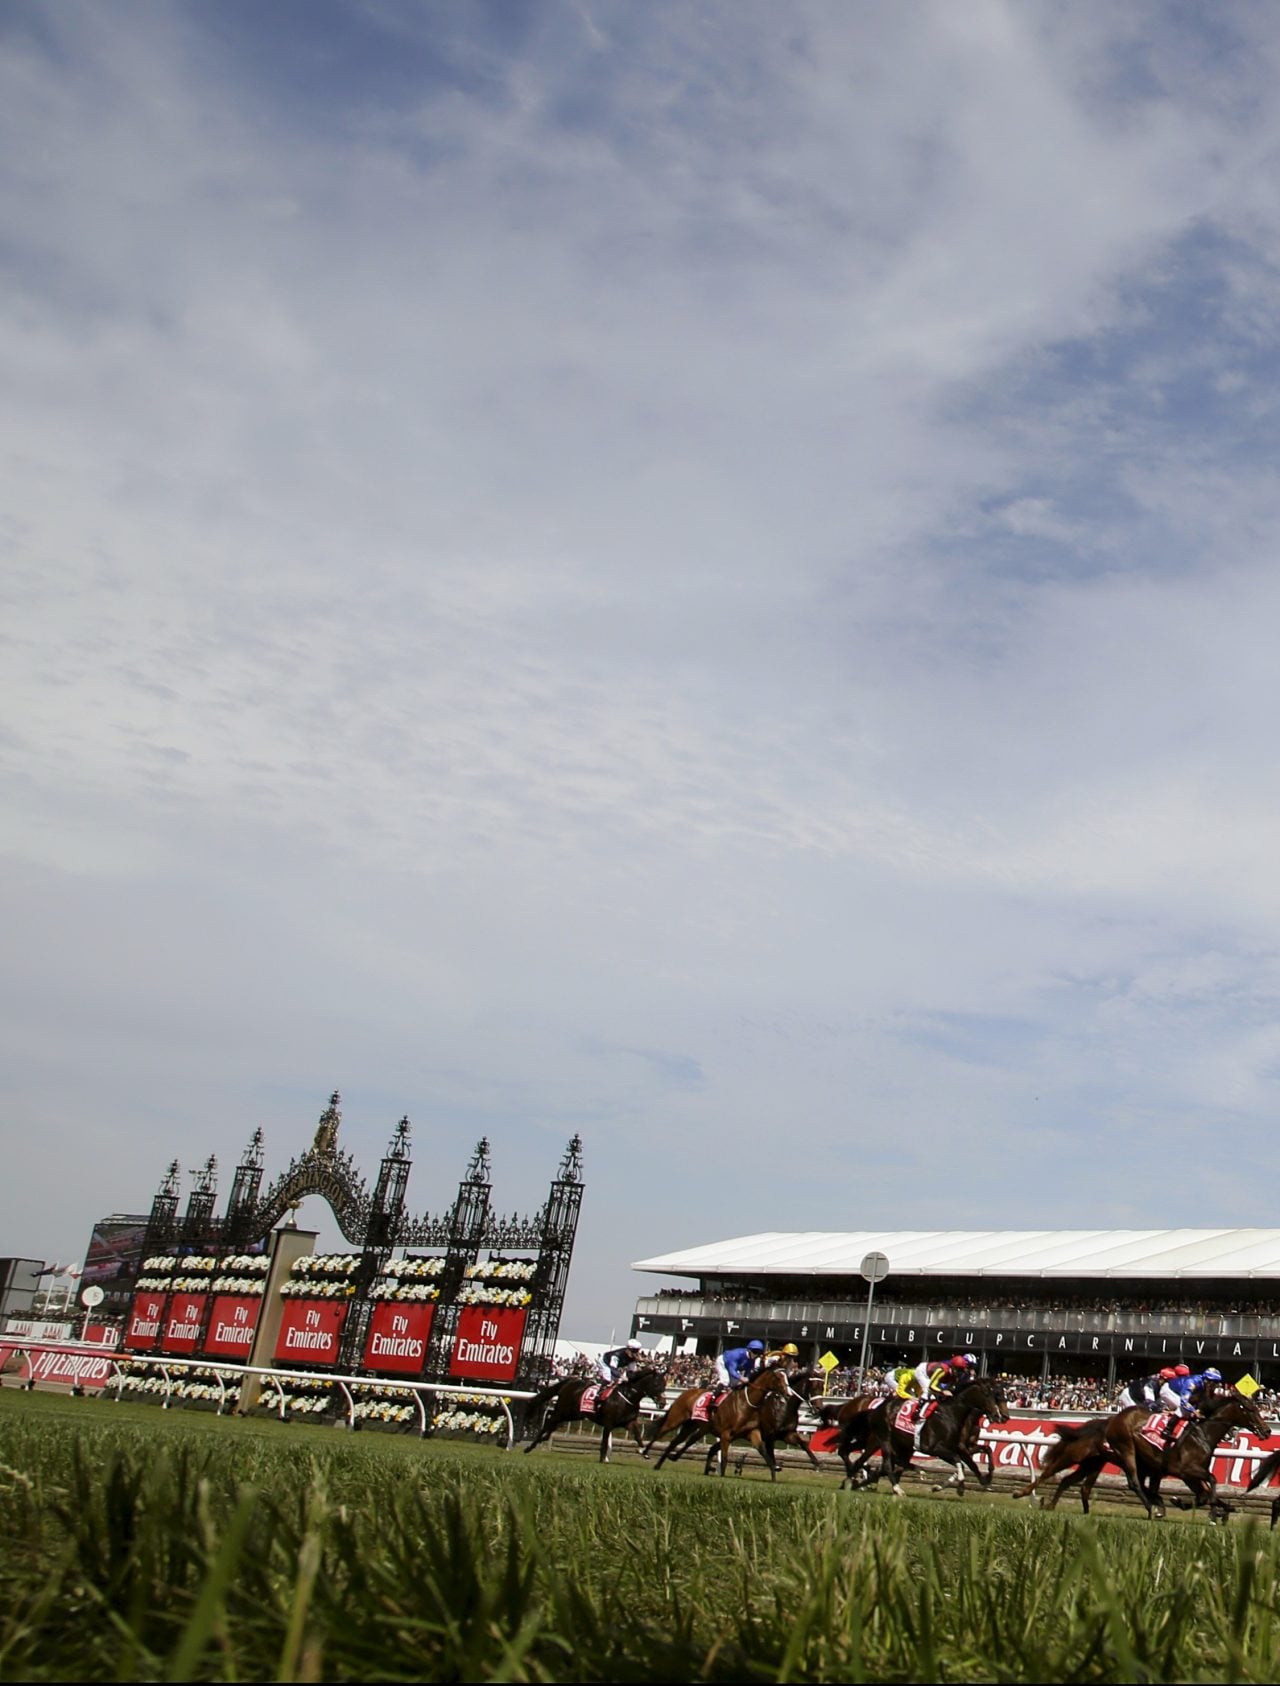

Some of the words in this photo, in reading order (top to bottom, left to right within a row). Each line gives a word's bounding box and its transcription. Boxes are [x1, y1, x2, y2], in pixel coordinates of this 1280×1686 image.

[147, 1303, 159, 1319] Fly
[185, 1304, 199, 1320] Fly
[235, 1306, 248, 1323] Fly
[306, 1309, 321, 1328] Fly
[131, 1317, 160, 1337] Emirat
[168, 1319, 200, 1340] Emirat
[215, 1322, 254, 1344] Emirate
[392, 1315, 409, 1335] Fly
[481, 1320, 498, 1341] Fly
[286, 1326, 333, 1350] Emirates
[371, 1332, 423, 1358] Emirates
[457, 1338, 514, 1365] Emirates
